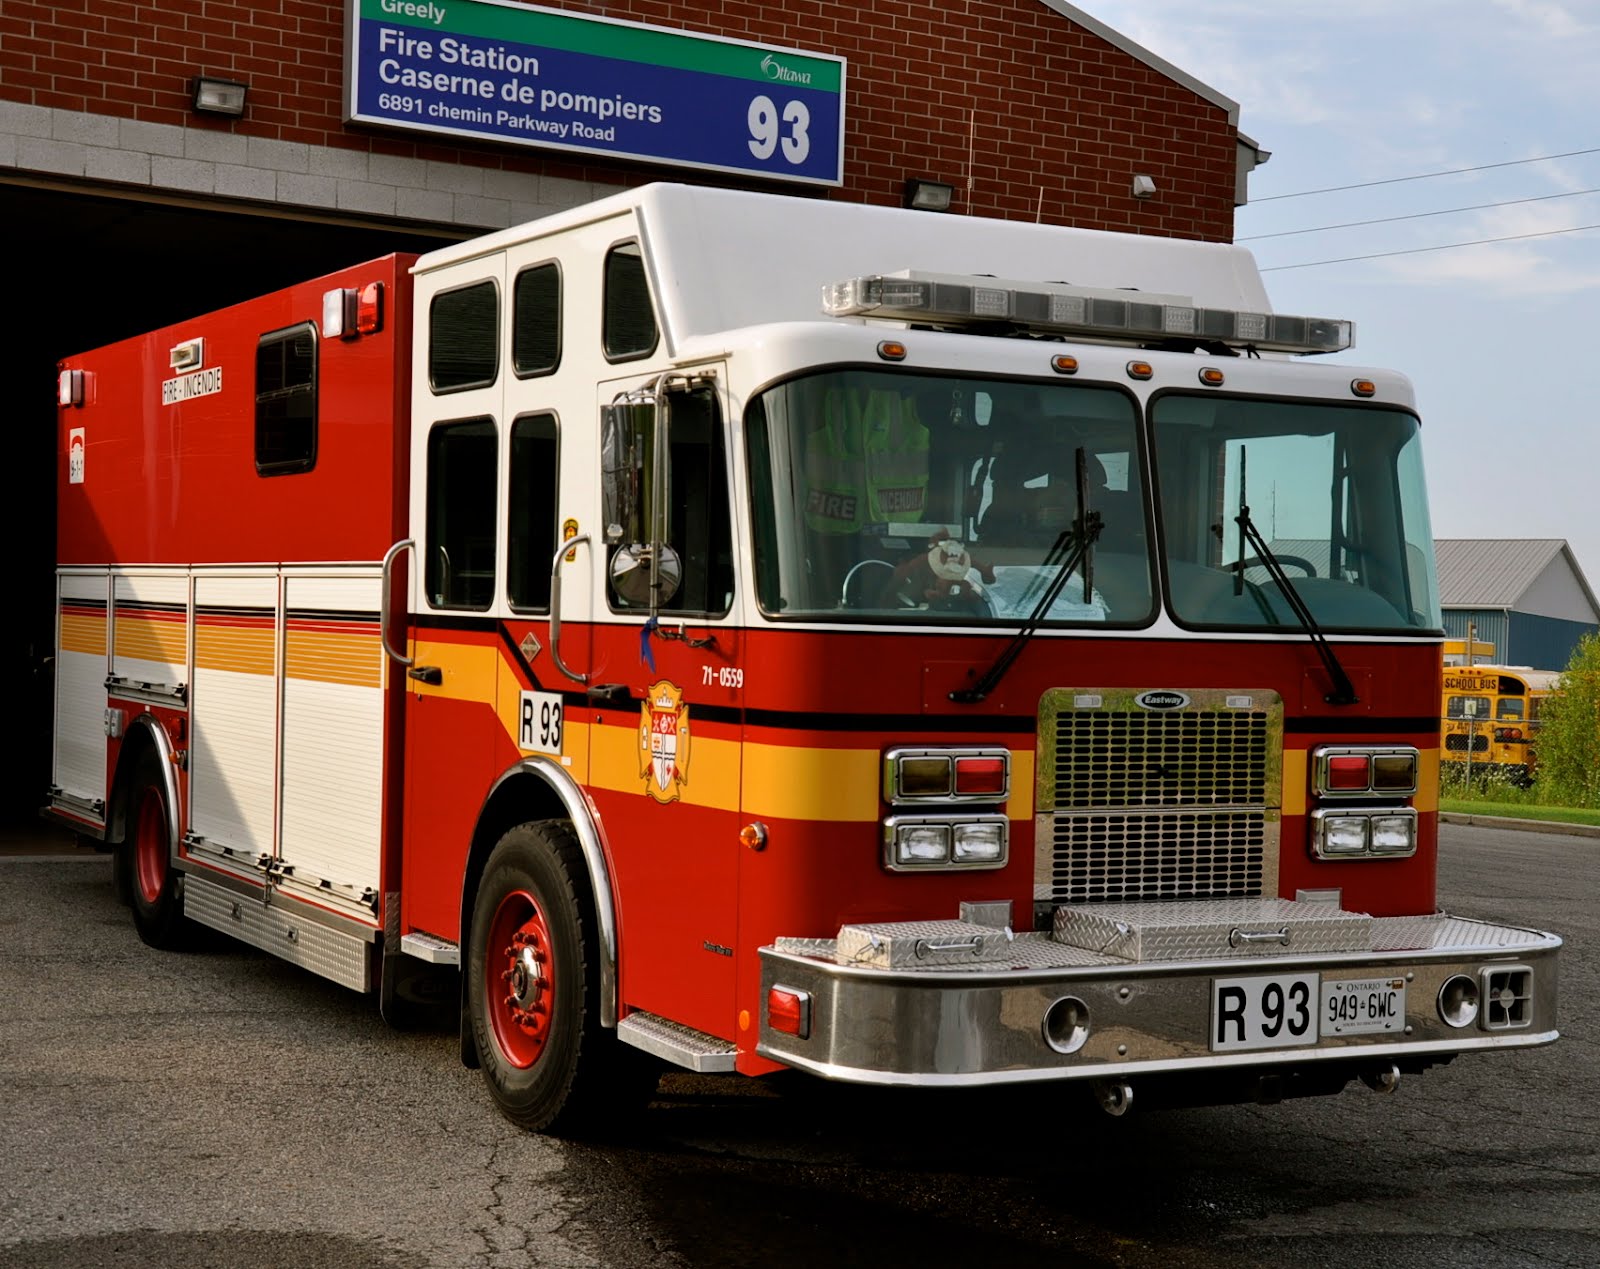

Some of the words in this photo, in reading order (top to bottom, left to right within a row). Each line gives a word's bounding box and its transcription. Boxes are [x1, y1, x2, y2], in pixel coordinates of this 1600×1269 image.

[381, 0, 446, 25] Greely
[379, 27, 433, 60] Fire
[439, 37, 539, 76] Station
[761, 54, 812, 84] Ottawa
[378, 58, 495, 99] Caserne
[500, 78, 535, 105] de
[540, 88, 662, 124] pompiers
[378, 93, 423, 115] 6891
[428, 101, 492, 125] chemin
[496, 110, 569, 138] Parkway
[572, 121, 615, 142] Road
[747, 94, 811, 165] 93
[163, 380, 178, 403] FIRE
[183, 368, 221, 398] INCENDIE
[806, 489, 856, 519] FIRE
[702, 665, 744, 688] 71-0559
[1444, 678, 1477, 689] SCHOOL
[1480, 679, 1496, 689] BUS
[1145, 695, 1182, 706] Eastway
[522, 697, 534, 744] R
[540, 700, 561, 748] 93
[1346, 982, 1381, 993] ONTARIO
[1217, 985, 1247, 1043] R
[1261, 981, 1310, 1038] 93
